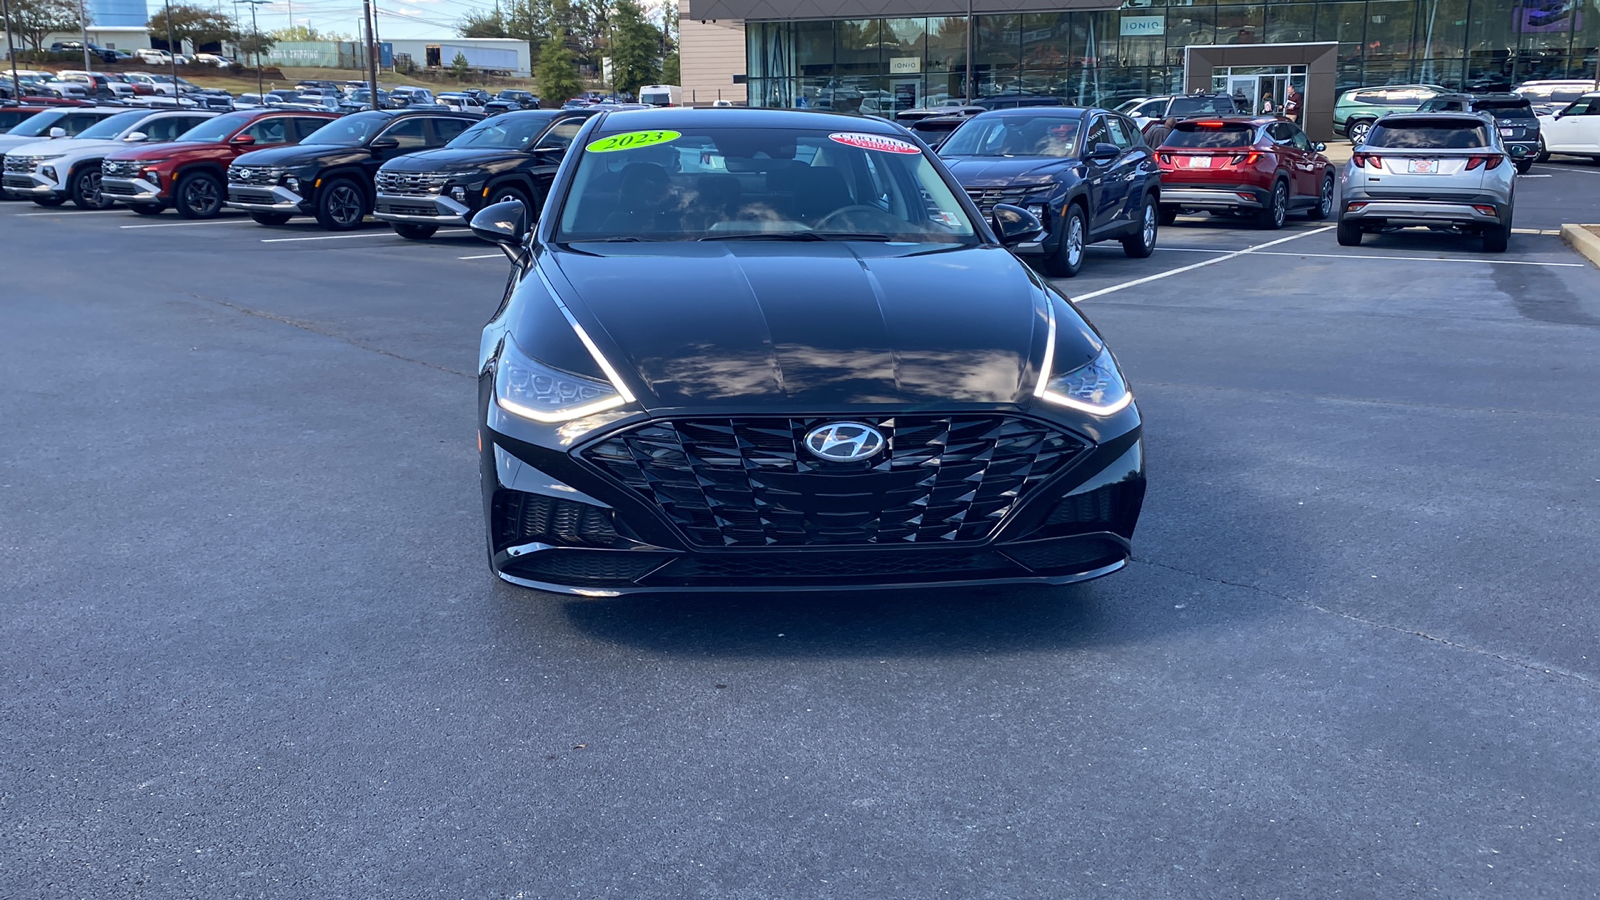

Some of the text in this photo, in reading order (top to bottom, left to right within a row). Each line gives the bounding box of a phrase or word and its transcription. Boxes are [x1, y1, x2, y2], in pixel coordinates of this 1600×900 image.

[289, 49, 319, 59] SHIPPING
[603, 132, 664, 149] 2023
[840, 133, 910, 148] CERTIFIED
